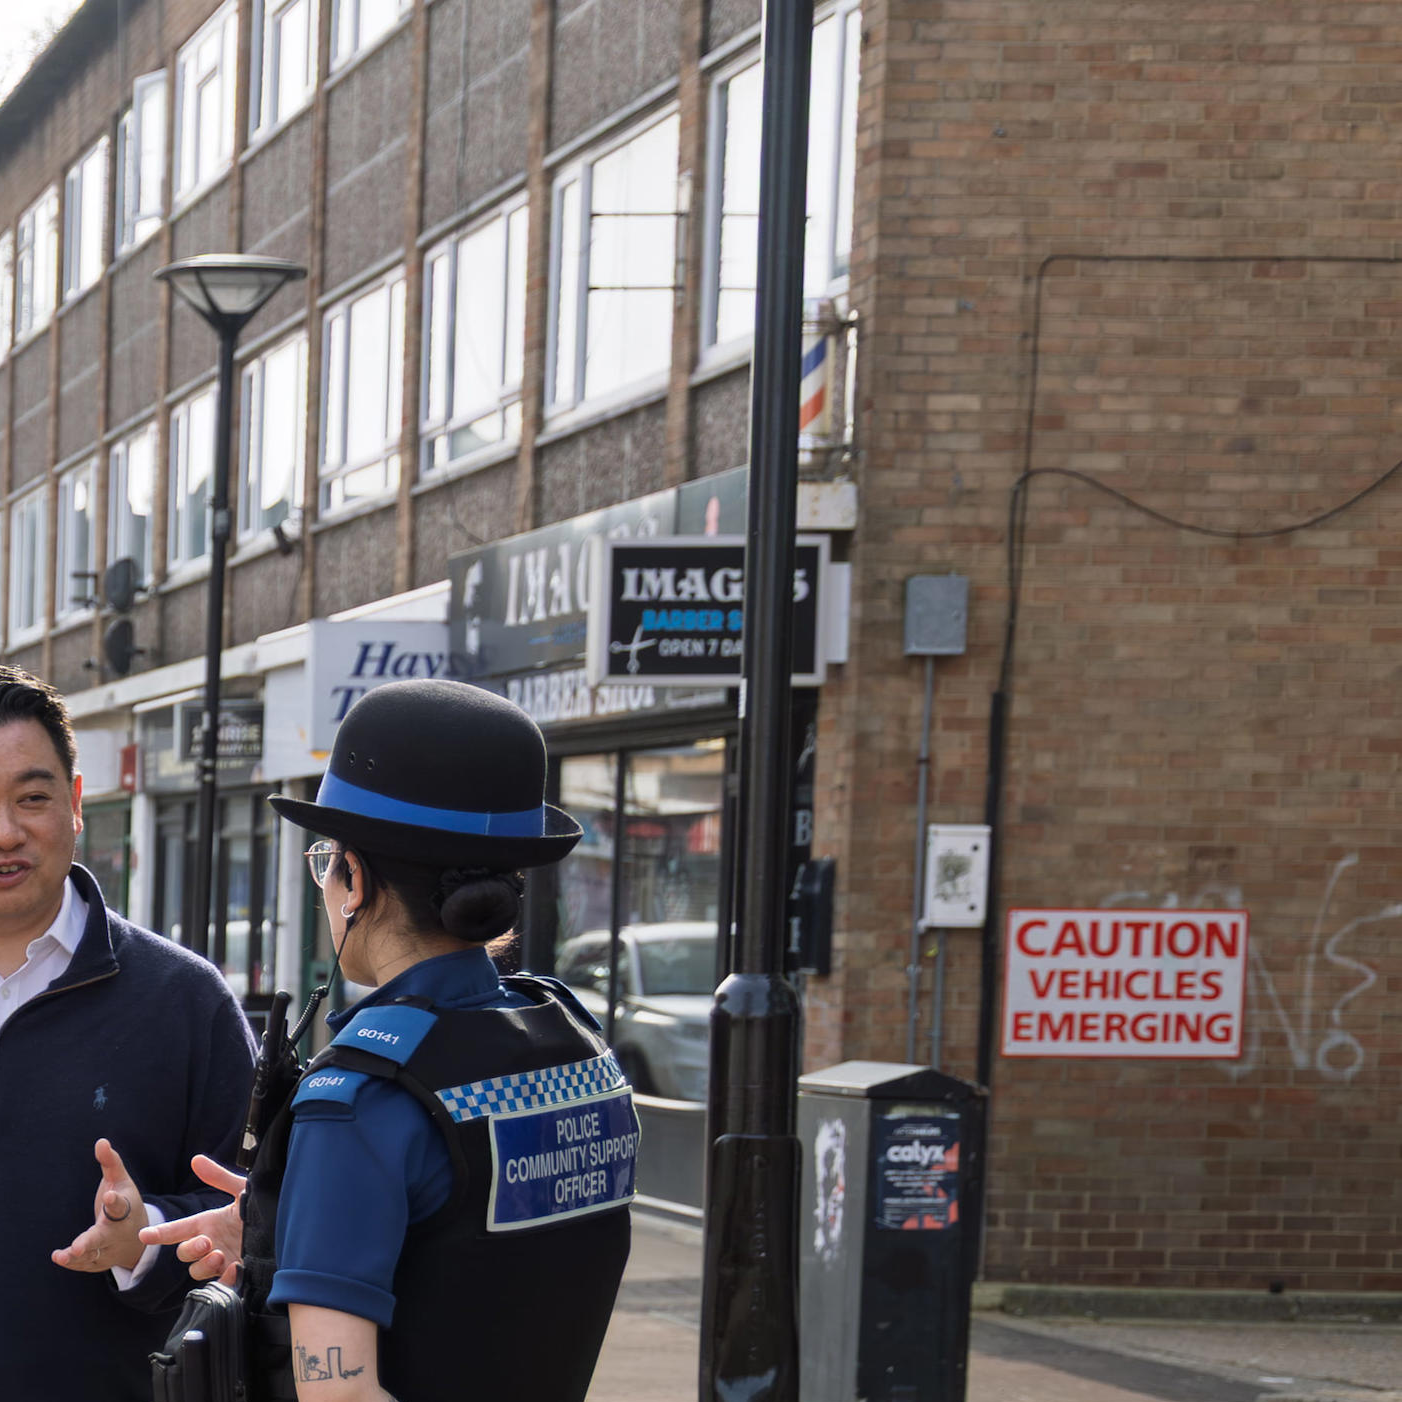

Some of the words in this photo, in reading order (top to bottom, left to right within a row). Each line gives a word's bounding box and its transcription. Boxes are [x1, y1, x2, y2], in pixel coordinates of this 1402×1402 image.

[642, 608, 724, 632] BARBER
[658, 638, 705, 657] OPEN
[707, 639, 719, 656] 7
[1015, 919, 1240, 959] CAUTION
[1028, 969, 1223, 1001] VEHICLES
[356, 1027, 400, 1046] 60141
[1011, 1012, 1233, 1043] EMERGING
[308, 1075, 346, 1089] 60141
[555, 1112, 600, 1145] POLICE
[506, 1147, 587, 1184] COMMUNITY
[589, 1131, 639, 1167] SUPPORT
[886, 1139, 946, 1167] calyx
[554, 1170, 607, 1204] OFFICER
